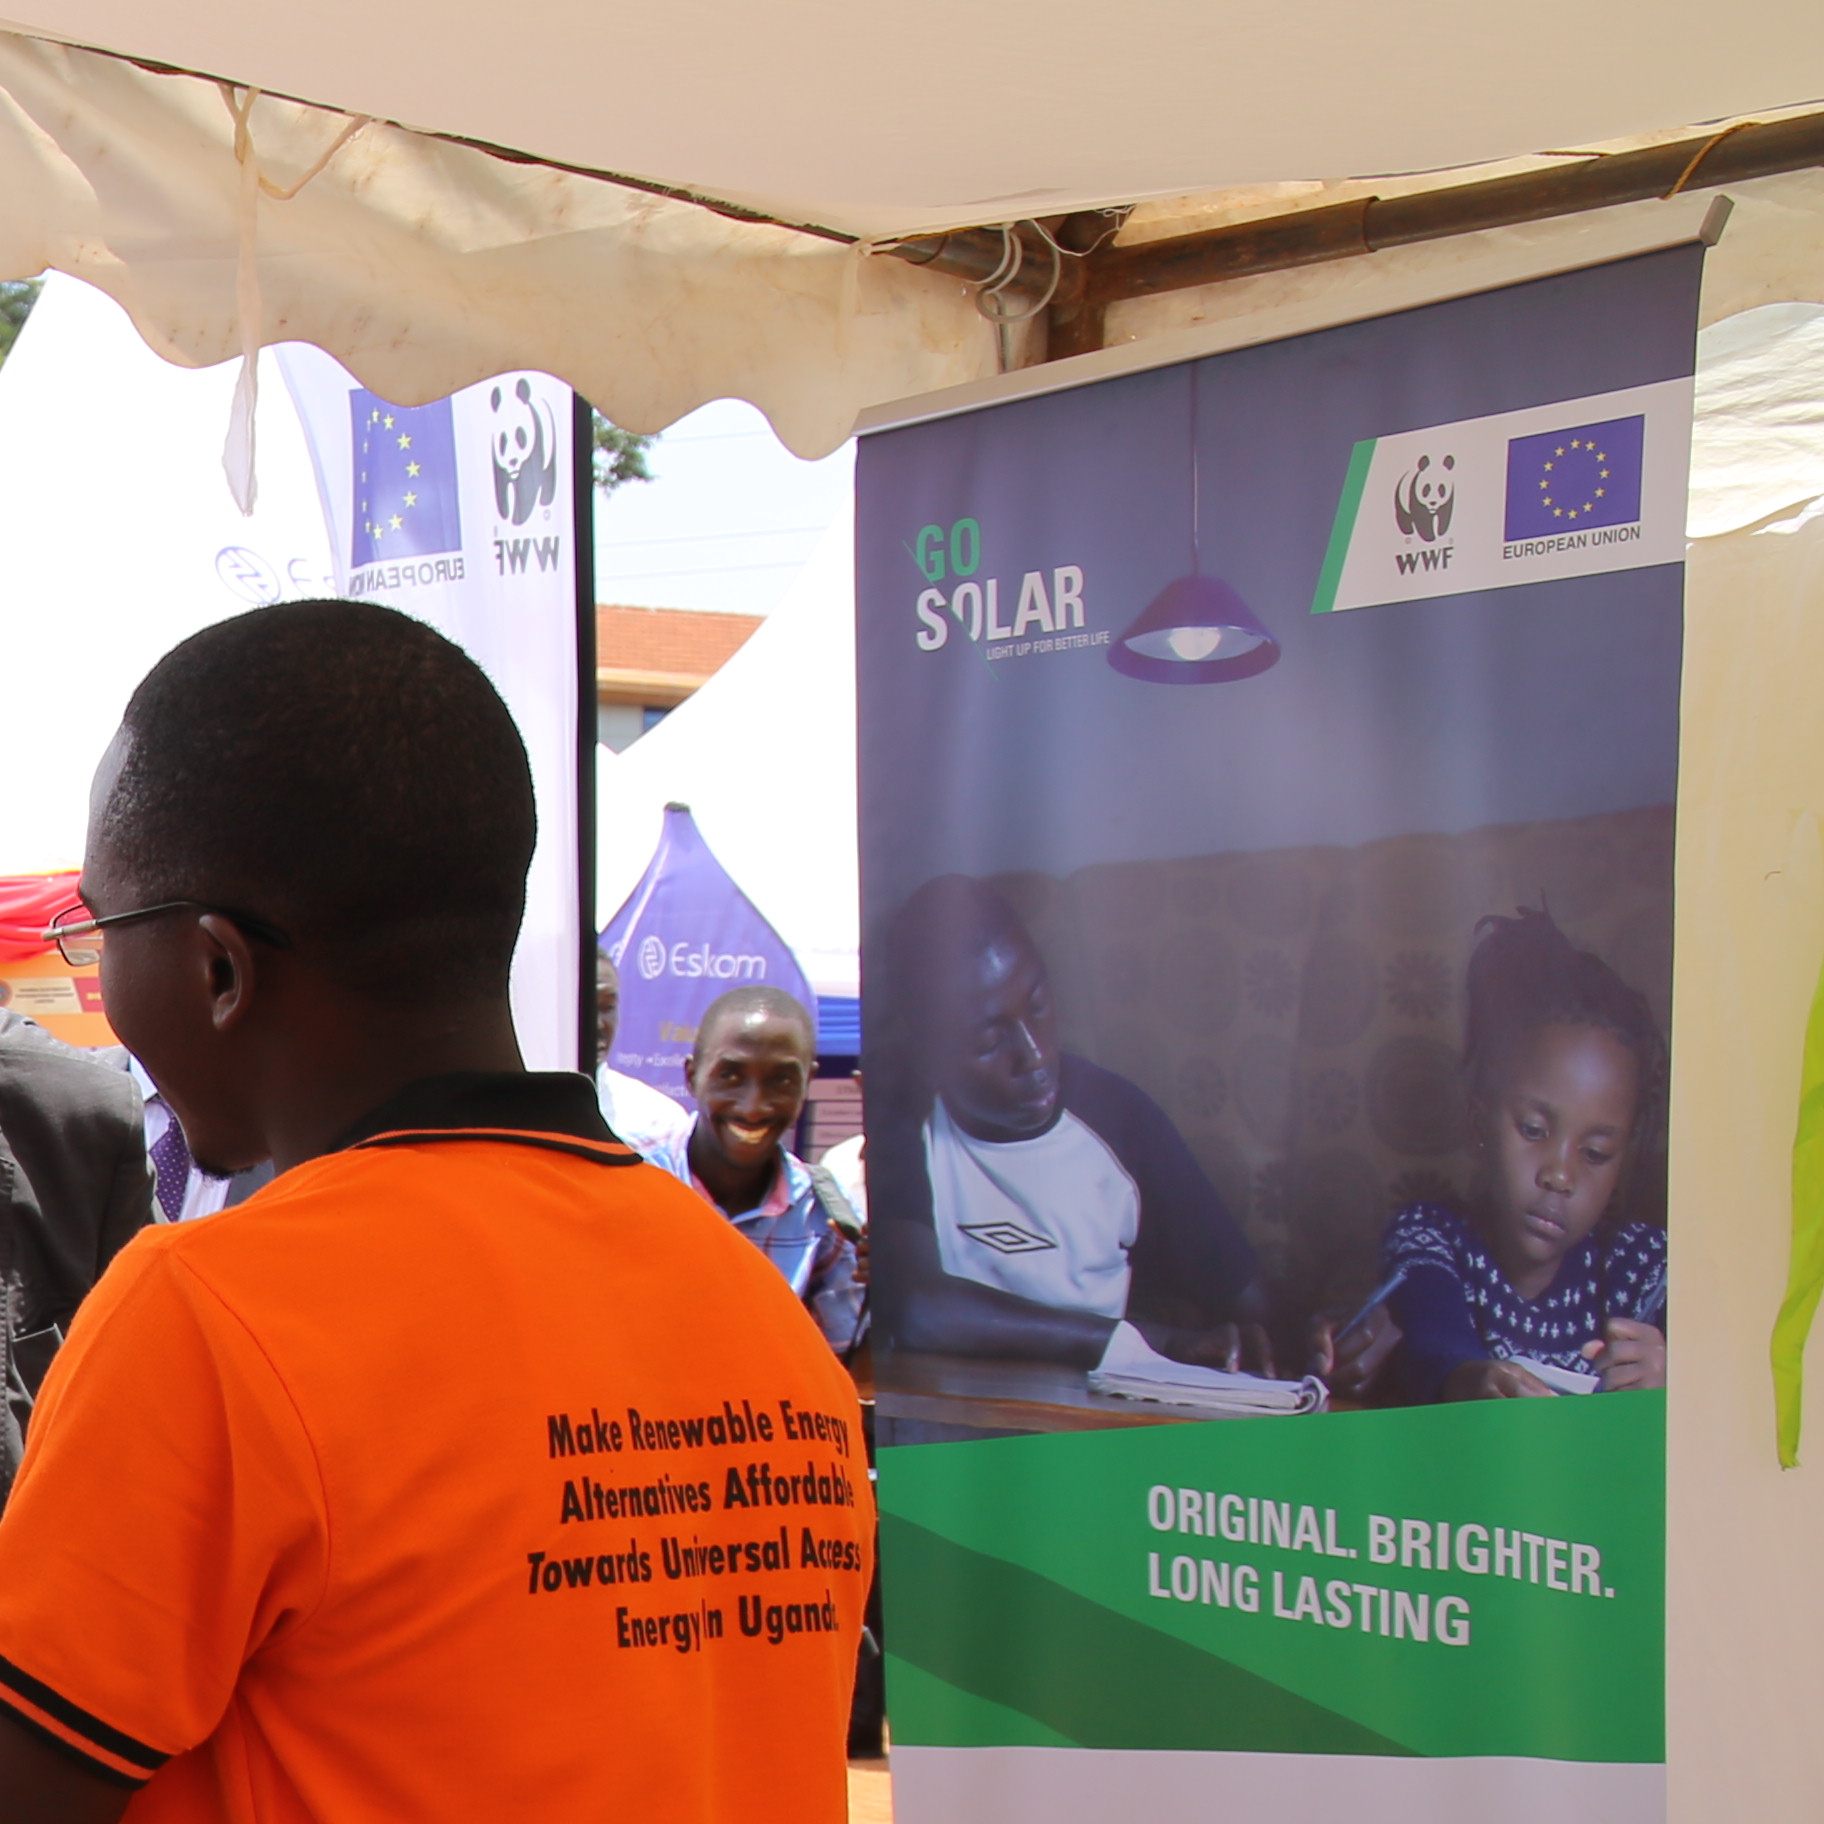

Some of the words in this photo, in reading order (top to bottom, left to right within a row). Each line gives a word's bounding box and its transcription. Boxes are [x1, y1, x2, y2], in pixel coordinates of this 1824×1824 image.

[916, 518, 981, 581] GO
[1395, 546, 1454, 575] WWF
[1503, 535, 1587, 560] EUROPEAN
[1592, 526, 1640, 546] UNION
[916, 565, 1085, 650] SOLAR
[987, 646, 1014, 660] LIGHT
[1017, 643, 1031, 656] UP
[1034, 640, 1053, 653] FOR
[1056, 634, 1088, 650] BETTER
[1091, 631, 1110, 646] LIFE
[671, 943, 766, 979] Eskom
[547, 1408, 622, 1458] Make
[628, 1400, 774, 1450] Renewable
[779, 1400, 849, 1458] Energy
[560, 1473, 711, 1523] Alternatives
[723, 1462, 854, 1509] Affordable
[527, 1538, 651, 1594] Towards
[661, 1526, 790, 1580] Universal
[802, 1527, 861, 1571] Access
[1148, 1484, 1357, 1558] ORIGINAL.
[1369, 1514, 1616, 1599] BRIGHTER.
[1148, 1552, 1259, 1613] LONG
[1273, 1570, 1470, 1647] LASTING
[616, 1607, 700, 1653] Energy
